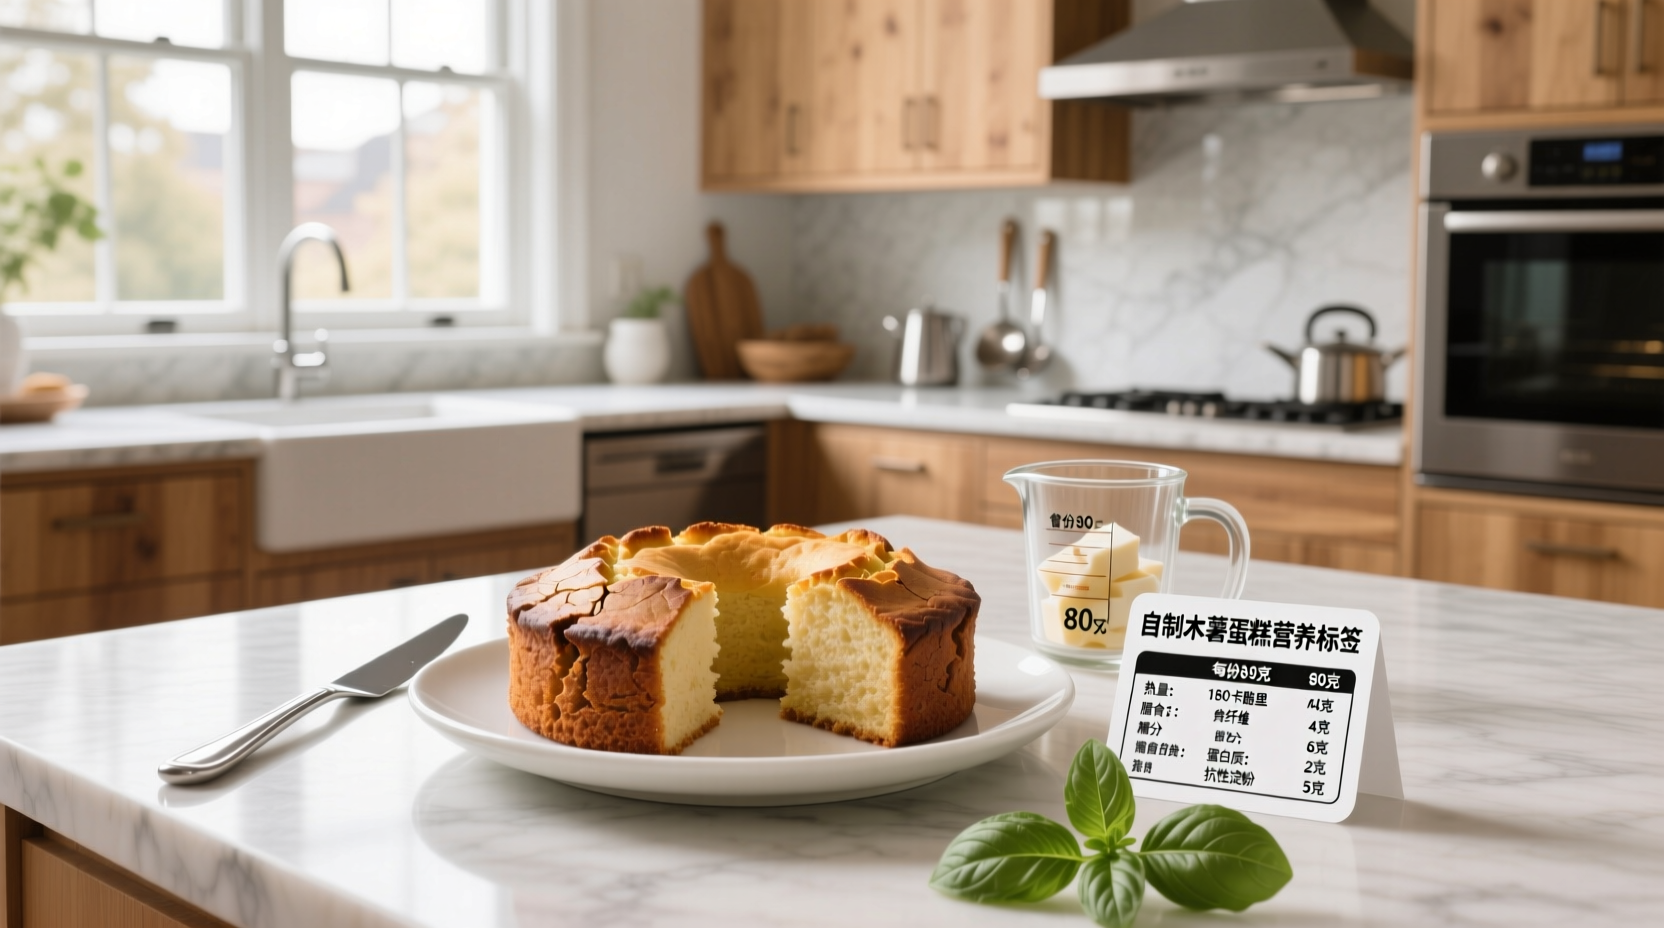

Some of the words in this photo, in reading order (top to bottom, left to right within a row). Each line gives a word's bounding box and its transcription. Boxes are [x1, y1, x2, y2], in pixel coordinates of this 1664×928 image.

[1141, 610, 1363, 655] 自制木薯蛋糕营养标签
[1308, 719, 1331, 735] 4克
[1306, 740, 1329, 755] 6克
[1304, 760, 1326, 775] 2克
[1302, 780, 1325, 796] 5克
